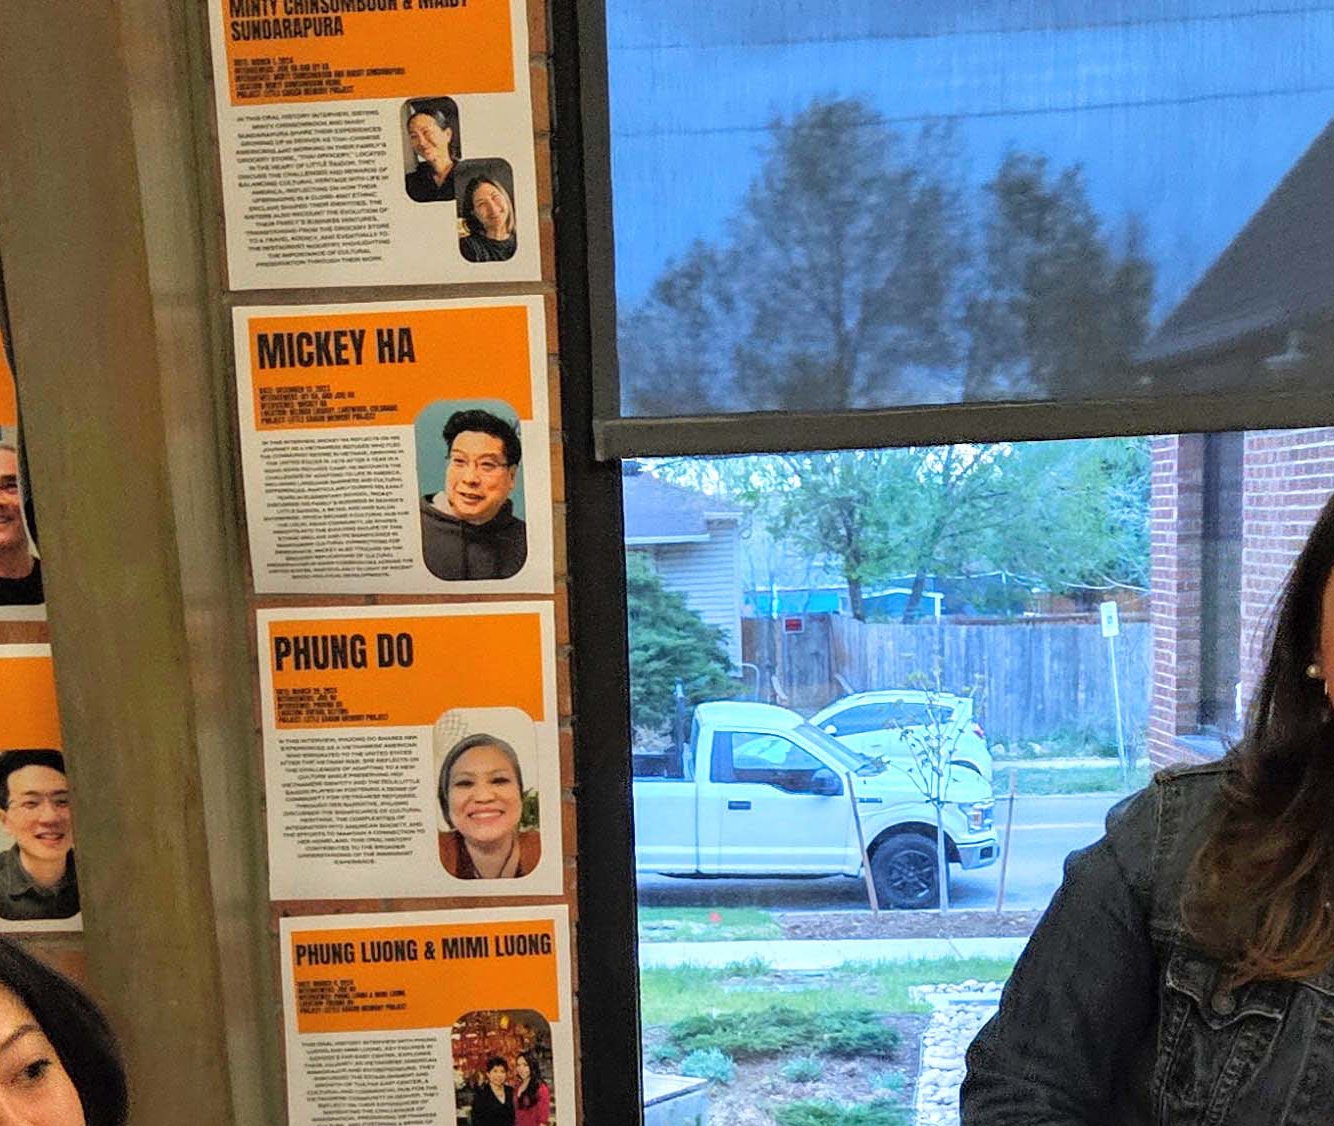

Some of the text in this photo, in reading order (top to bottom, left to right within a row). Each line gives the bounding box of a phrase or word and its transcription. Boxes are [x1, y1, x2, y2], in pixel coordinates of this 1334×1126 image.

[231, 16, 344, 41] SUNDARAPURA
[257, 327, 416, 369] MICKEY HA
[274, 632, 414, 671] PHUNG DO
[295, 933, 552, 966] PHUNG LUONG & MIMI LUONG
